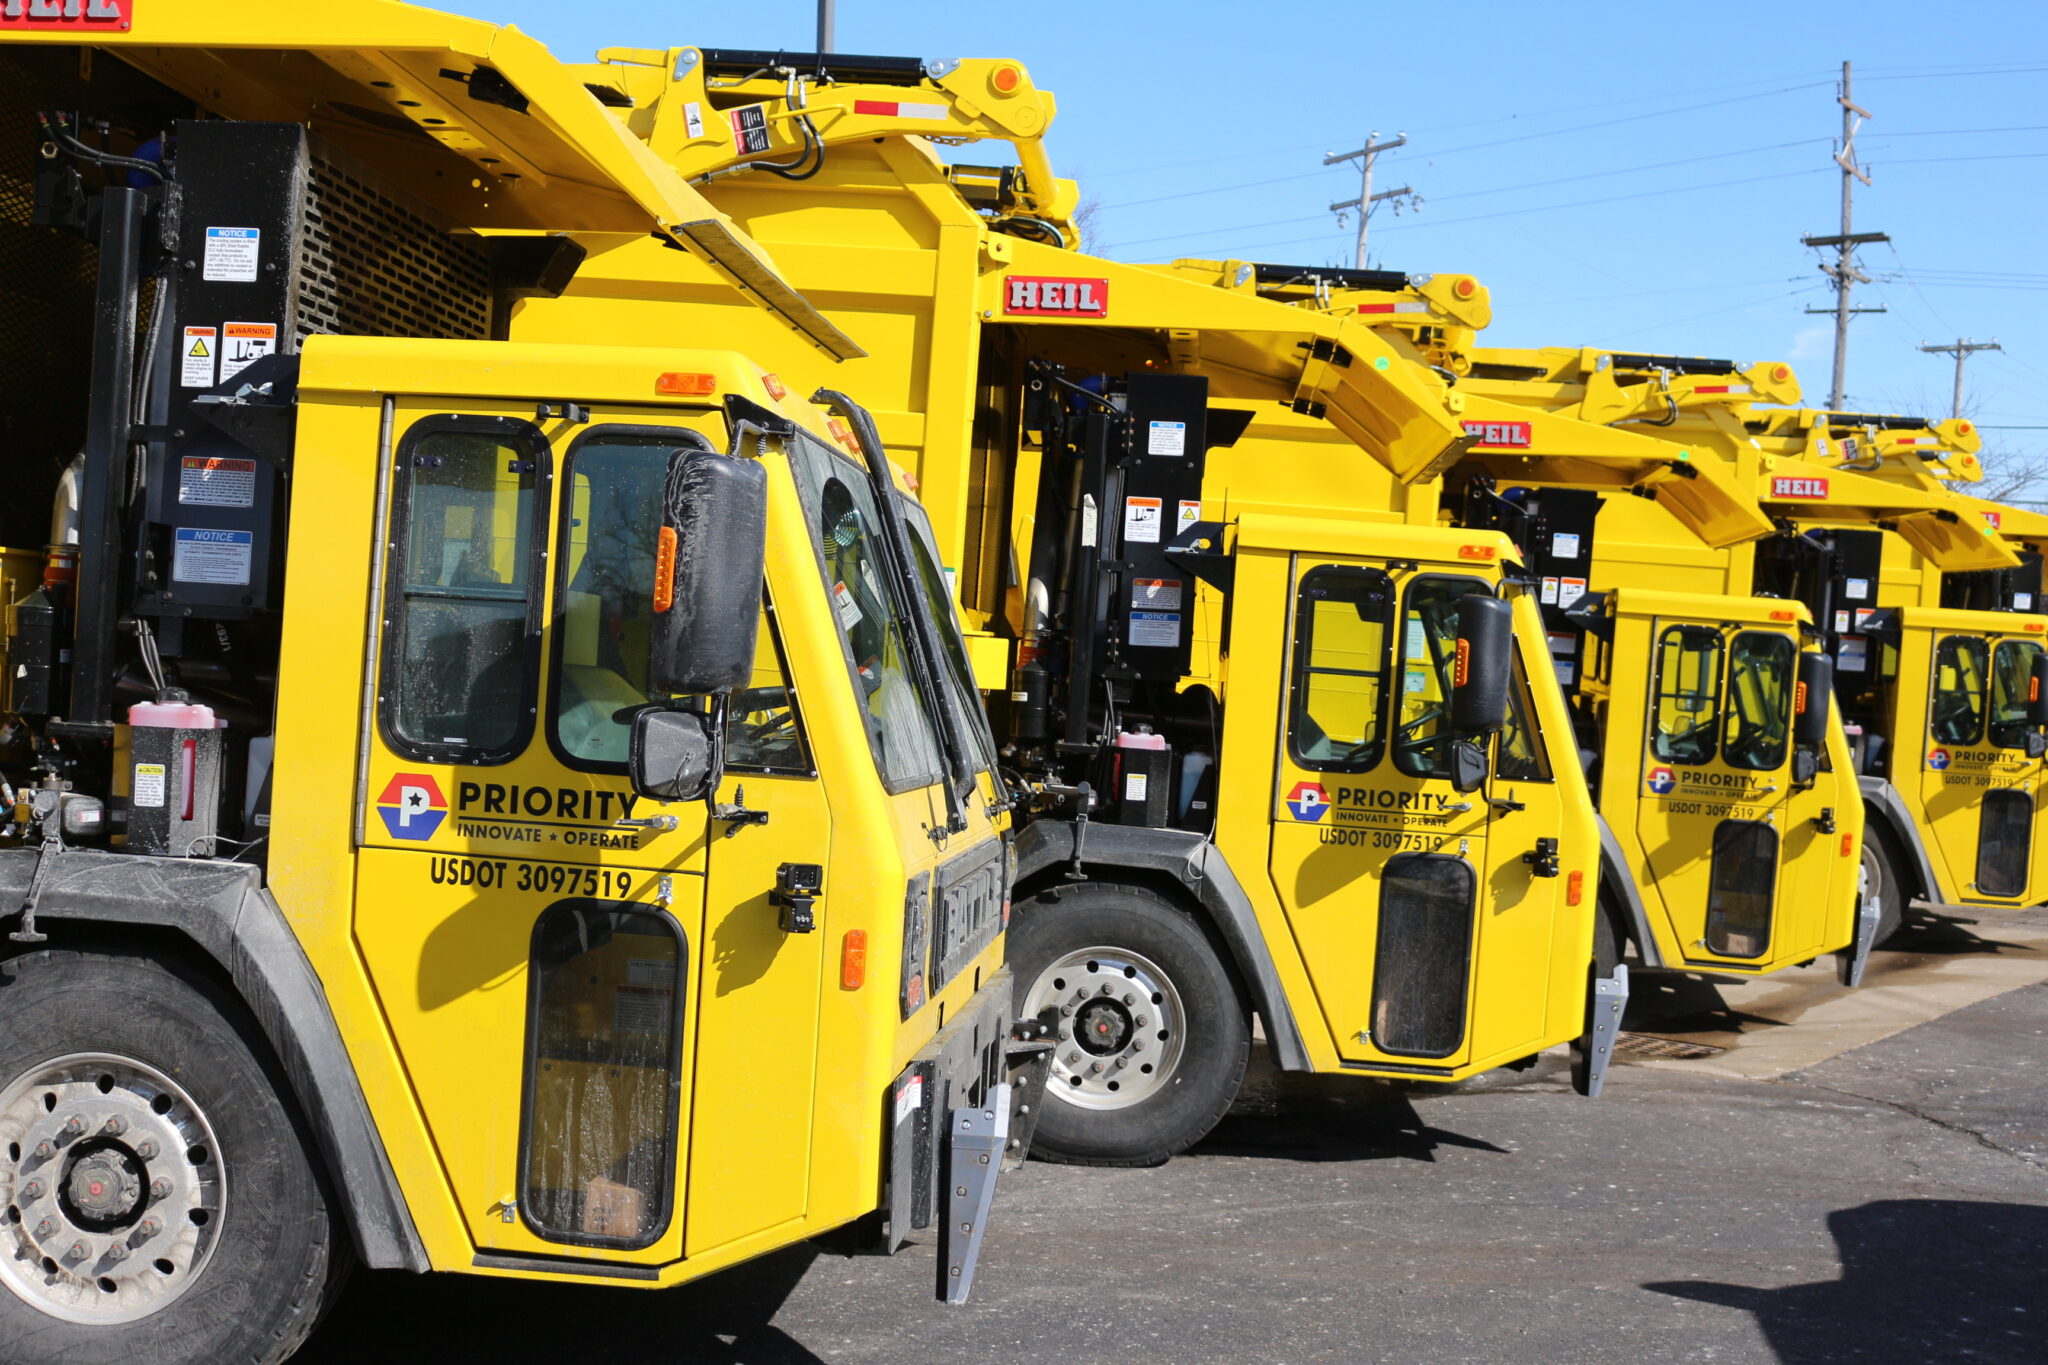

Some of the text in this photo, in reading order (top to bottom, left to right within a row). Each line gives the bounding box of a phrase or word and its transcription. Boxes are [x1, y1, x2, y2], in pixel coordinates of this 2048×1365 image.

[1011, 281, 1101, 310] HEIL
[236, 327, 271, 335] WARNING
[1465, 424, 1527, 443] HEIL
[1775, 479, 1825, 496] HEIL
[194, 531, 235, 542] NOTICE
[1955, 751, 2016, 763] PRIORITY
[1681, 771, 1758, 788] PRIORITY
[1945, 775, 1971, 785] USDOT
[459, 781, 639, 821] PRIORITY
[1337, 787, 1449, 812] PRIORITY
[1668, 801, 1754, 818] USDOT 3097519
[1336, 811, 1449, 827] INNOVATE OPERATE
[457, 823, 639, 849] INNOVATE OPERATE
[1319, 828, 1443, 852] USDOT 3097519
[430, 857, 632, 899] USDOT 3097519
